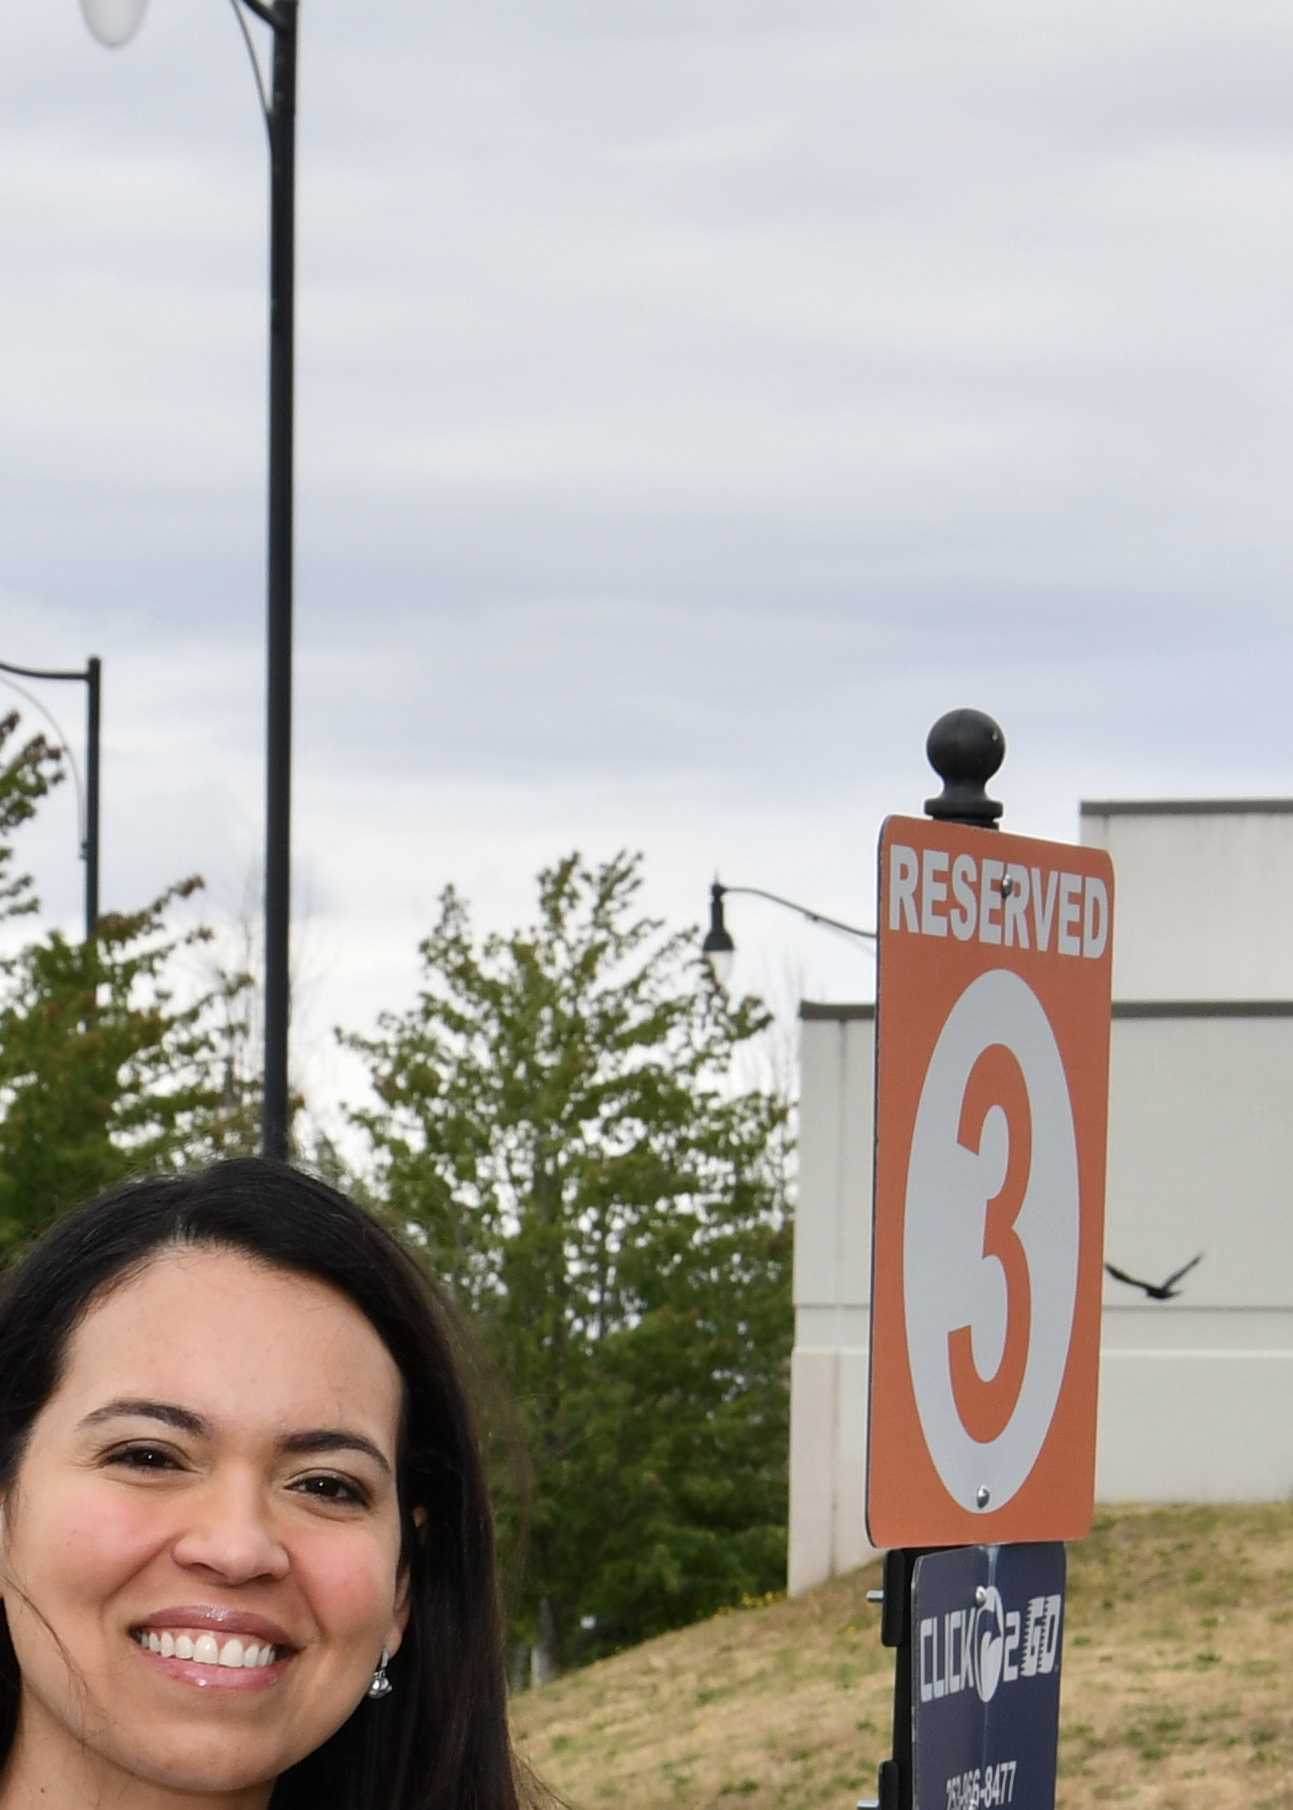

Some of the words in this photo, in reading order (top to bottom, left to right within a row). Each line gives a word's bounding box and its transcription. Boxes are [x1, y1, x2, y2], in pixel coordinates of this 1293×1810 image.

[889, 844, 1108, 960] RESERVED
[947, 1042, 1033, 1445] 3
[920, 1607, 976, 1702] CLICK
[1003, 1611, 1021, 1682] 2
[1021, 1594, 1062, 1676] GO
